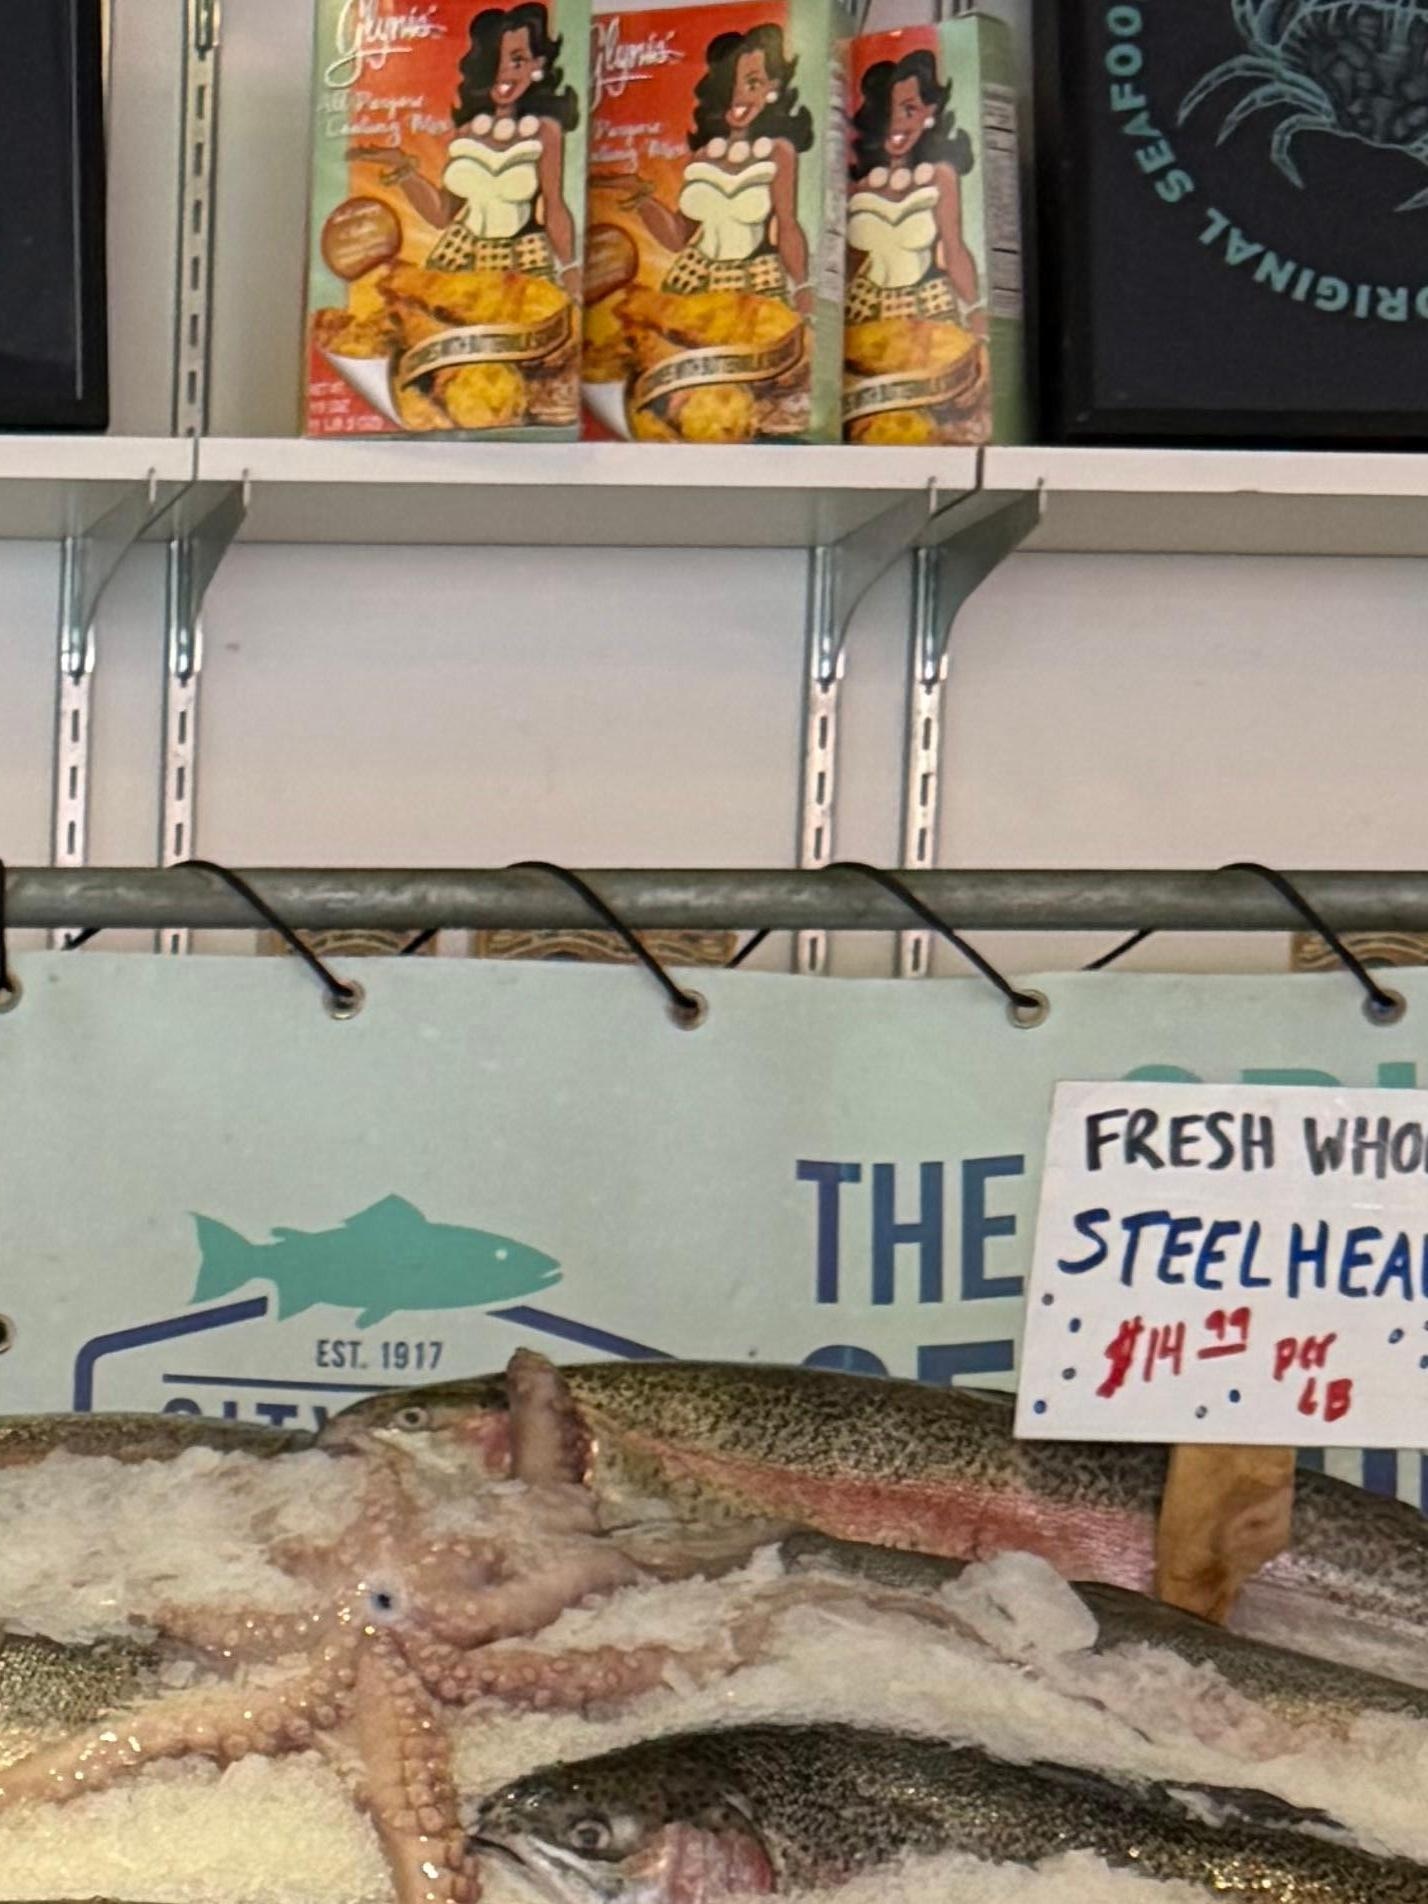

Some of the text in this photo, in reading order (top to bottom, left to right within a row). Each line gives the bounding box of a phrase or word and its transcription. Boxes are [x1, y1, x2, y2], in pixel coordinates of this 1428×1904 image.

[1085, 1108, 1428, 1180] FRESH WHO
[796, 1154, 1025, 1306] THE
[1057, 1207, 1428, 1301] STEELHEA
[316, 1340, 443, 1370] EST. 1917
